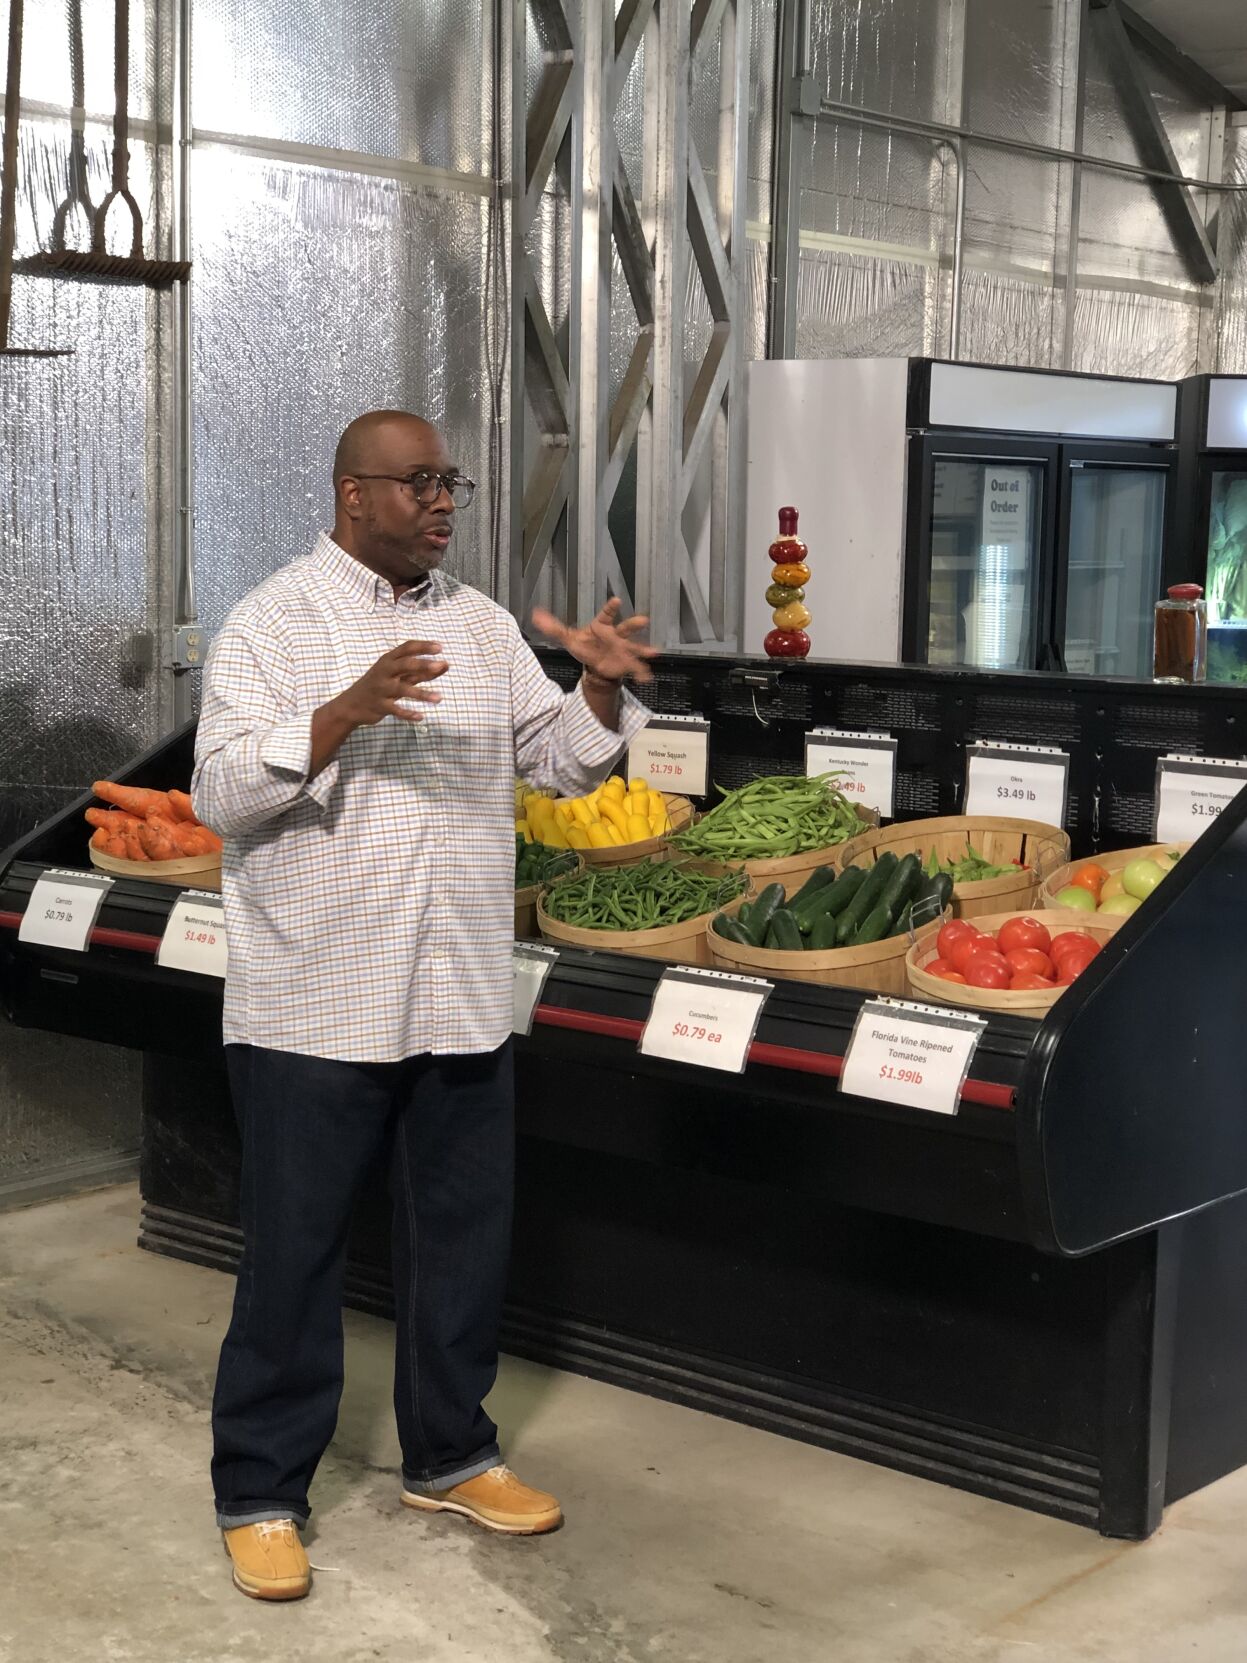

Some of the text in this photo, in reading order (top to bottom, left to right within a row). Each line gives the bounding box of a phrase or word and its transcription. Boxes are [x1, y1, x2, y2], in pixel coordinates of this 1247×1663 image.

[990, 478, 1008, 492] Out
[990, 500, 1019, 513] Order
[648, 749, 687, 760] Yellow Squash
[828, 758, 849, 766] Kentucky
[650, 763, 683, 775] $1.79 lb
[1010, 775, 1023, 783] Okra
[857, 782, 866, 793] lb
[997, 786, 1036, 801] $3.49 lb
[1191, 802, 1222, 817] $1.99
[55, 896, 73, 906] Carrots
[44, 909, 73, 922] $0.79 lb
[184, 915, 209, 926] Butternut
[184, 930, 216, 945] $1.49 lb
[688, 1010, 719, 1022] Cucumbers
[672, 1021, 723, 1044] $0.79 ea
[871, 1029, 954, 1054] Florida Vine Ripened
[888, 1047, 927, 1064] Tomatoes
[878, 1064, 923, 1085] $1.99lb
